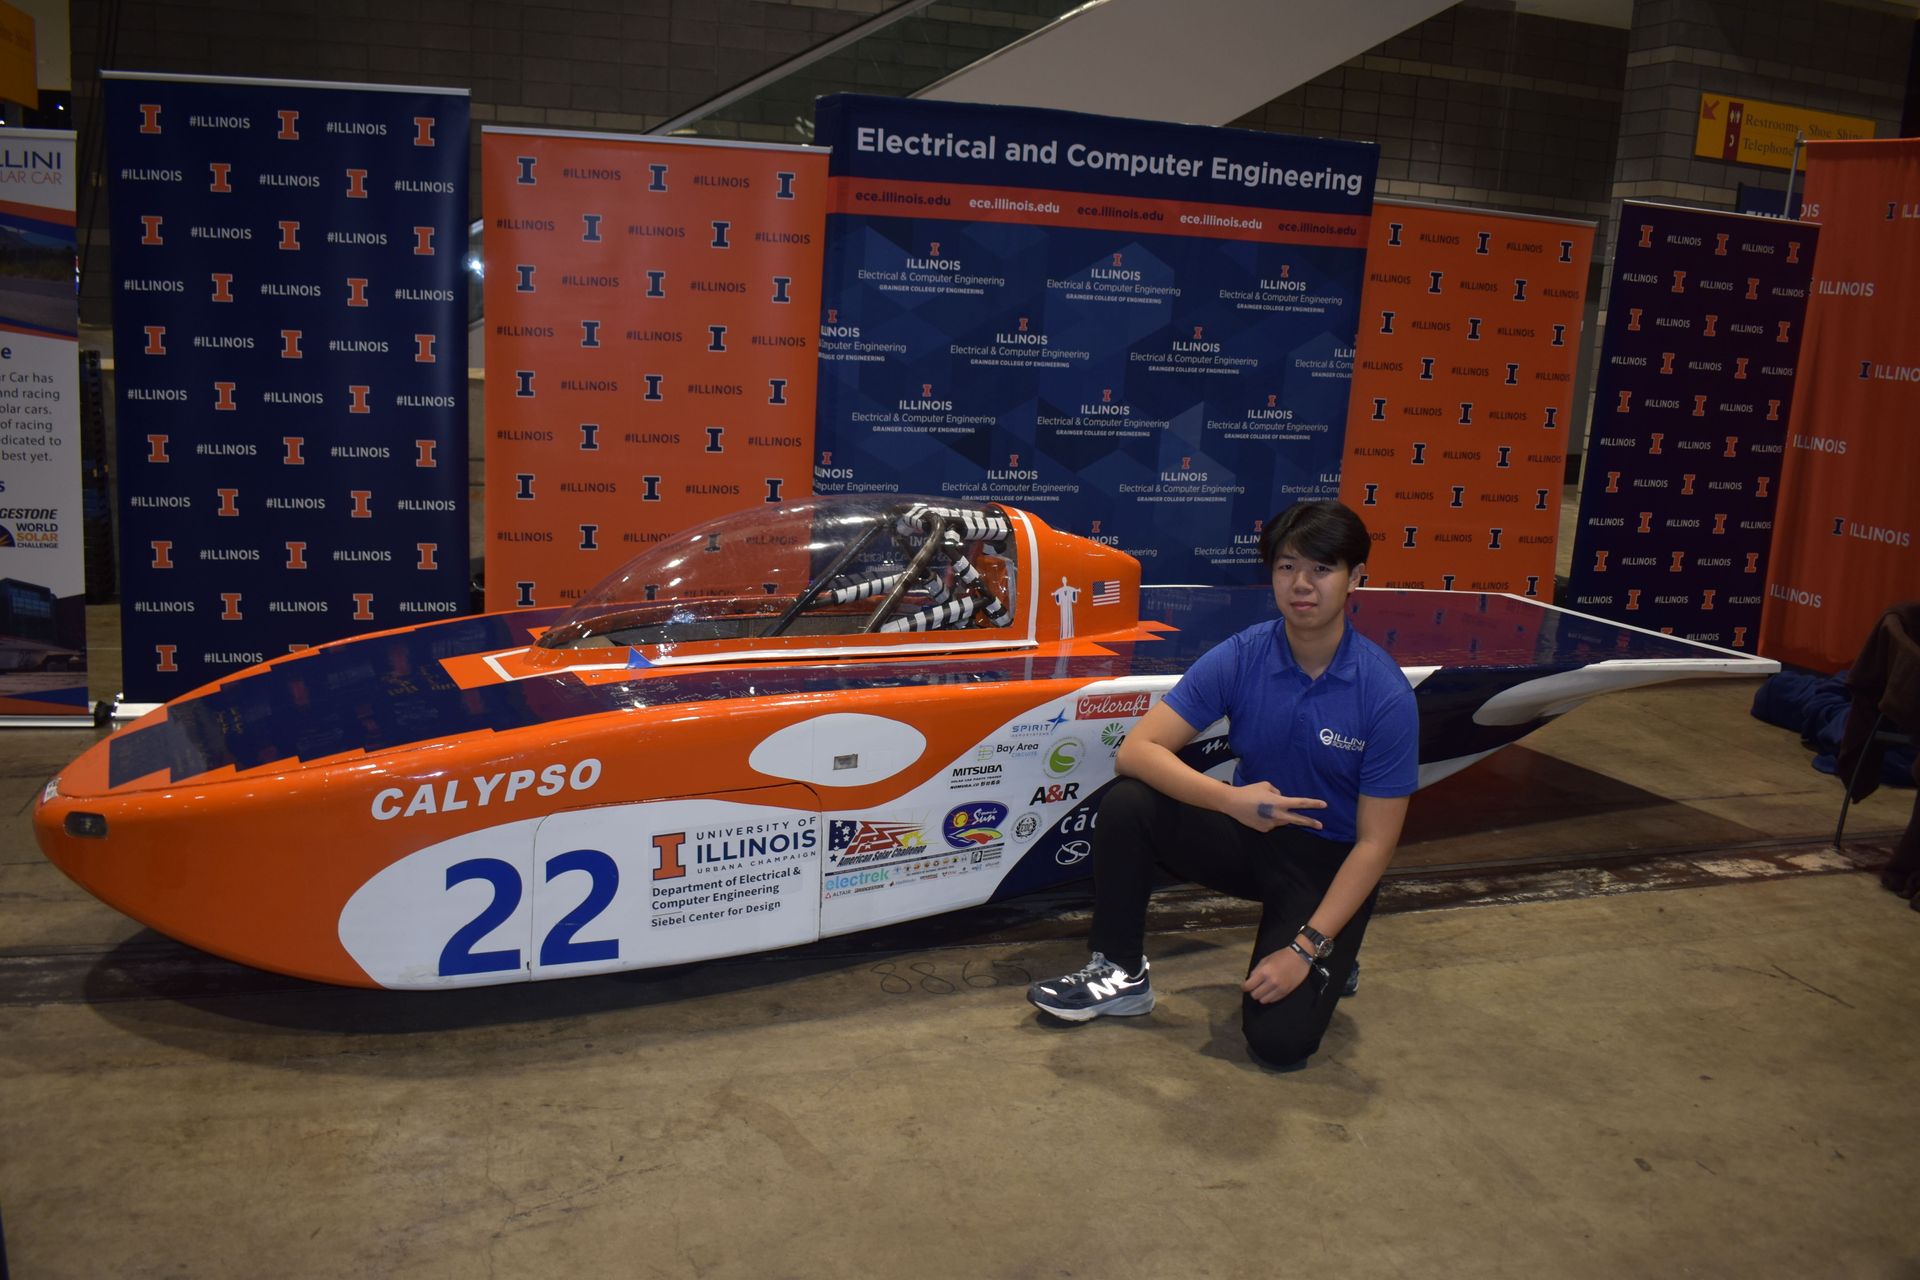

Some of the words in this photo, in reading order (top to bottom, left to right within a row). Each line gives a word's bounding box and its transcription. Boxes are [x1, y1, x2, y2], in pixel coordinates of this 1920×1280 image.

[189, 116, 250, 129] #ILLINOIS
[327, 122, 387, 135] #ILLINOIS
[857, 127, 995, 160] Electrical
[1005, 141, 1057, 164] and
[1067, 143, 1203, 177] Computer
[1211, 157, 1362, 195] Engineering
[32, 171, 62, 184] CAR
[121, 168, 182, 182] #ILLINOIS
[563, 168, 621, 181] #ILLINOIS
[259, 174, 320, 188] #ILLINOIS
[395, 180, 454, 194] #ILLINOIS
[693, 176, 750, 189] #ILLINOIS
[855, 191, 951, 206] ece.illinois.edu
[969, 198, 1060, 213] ece.illinois.edu
[1077, 205, 1164, 221] ece.illinois.edu
[1180, 214, 1262, 230] ece.illinois.edu
[191, 227, 252, 240] #ILLINOIS
[1278, 222, 1356, 236] ece.illinois.edu
[327, 232, 388, 245] #ILLINOIS
[755, 232, 811, 245] #ILLINOIS
[1420, 233, 1460, 245] #ILLINOIS
[1667, 235, 1701, 246] #ILLINOIS
[906, 258, 961, 270] ILLINOIS
[858, 270, 898, 280] Electrical
[901, 272, 906, 280] &
[909, 273, 952, 284] Computer
[955, 275, 1005, 286] Engineering
[1091, 268, 1141, 280] ILLINOIS
[1371, 273, 1411, 285] #ILLINOIS
[1623, 273, 1658, 284] #ILLINOIS
[562, 275, 619, 288] #ILLINOIS
[1047, 279, 1083, 290] Electrical
[1086, 282, 1091, 290] &
[1094, 282, 1132, 293] Computer
[1135, 284, 1181, 296] Engineering
[1260, 280, 1306, 291] ILLINOIS
[1460, 281, 1497, 292] #ILLINOIS
[1700, 280, 1733, 291] #ILLINOIS
[1819, 280, 1874, 297] ILLINOIS
[1412, 321, 1450, 331] #ILLINOIS
[1656, 318, 1690, 329] #ILLINOIS
[626, 330, 683, 342] #ILLINOIS
[996, 334, 1048, 345] ILLINOIS
[951, 345, 988, 355] Electrical
[991, 347, 996, 355] &
[999, 347, 1039, 357] Computer
[1042, 349, 1089, 360] Engineering
[1173, 341, 1220, 352] ILLINOIS
[1452, 367, 1489, 377] #ILLINOIS
[1689, 361, 1722, 372] #ILLINOIS
[10, 372, 28, 382] Car
[33, 372, 54, 383] has
[561, 381, 618, 392] #ILLINOIS
[22, 389, 60, 402] racing
[128, 389, 188, 401] #ILLINOIS
[25, 406, 52, 415] cars.
[899, 400, 952, 411] ILLINOIS
[1081, 405, 1130, 415] ILLINOIS
[1720, 403, 1753, 413] #ILLINOIS
[1248, 409, 1293, 419] ILLINOIS
[1404, 407, 1442, 417] #ILLINOIS
[852, 412, 891, 422] Electrical
[893, 414, 899, 422] &
[902, 413, 944, 424] Computer
[947, 415, 996, 425] Engineering
[1, 419, 11, 428] of
[16, 421, 52, 432] racing
[50, 437, 61, 446] to
[748, 437, 802, 447] #ILLINOIS
[1600, 437, 1635, 447] #ILLINOIS
[1793, 434, 1846, 455] ILLINOIS
[197, 444, 257, 456] #ILLINOIS
[2, 450, 26, 460] best
[31, 452, 52, 463] yet.
[987, 470, 1038, 480] ILLINOIS
[1161, 472, 1208, 481] ILLINOIS
[685, 484, 740, 495] #ILLINOIS
[942, 482, 979, 492] Electrical
[982, 483, 987, 491] &
[990, 483, 1030, 493] Computer
[1032, 484, 1079, 493] Engineering
[1634, 479, 1668, 488] #ILLINOIS
[1395, 491, 1434, 501] #ILLINOIS
[266, 498, 325, 509] #ILLINOIS
[16, 522, 58, 532] WORLD
[17, 532, 58, 541] SOLAR
[1435, 534, 1472, 543] #ILLINOIS
[1850, 522, 1910, 546] ILLINOIS
[200, 549, 259, 561] #ILLINOIS
[1697, 558, 1731, 567] #ILLINOIS
[1770, 584, 1822, 608] ILLINOIS
[135, 601, 195, 613] #ILLINOIS
[204, 652, 263, 664] #ILLINOIS
[1078, 694, 1150, 716] Coilcraft
[1012, 724, 1050, 732] SPIRIT
[1334, 733, 1365, 746] ILLINI
[996, 744, 1014, 753] Bay
[1016, 742, 1039, 751] Area
[953, 765, 1002, 777] MITSUBA
[371, 758, 603, 821] CALYPSO
[1029, 783, 1080, 806] A&R
[696, 821, 790, 840] UNIVERSITY
[798, 816, 817, 827] OF
[697, 829, 816, 864] ILLINOIS
[837, 852, 874, 867] American
[872, 851, 892, 862] Solar
[891, 845, 927, 858] Challenge
[698, 863, 743, 874] URBANA
[751, 851, 816, 867] CHAMPAIGN
[652, 877, 723, 897] Department
[726, 877, 737, 887] of
[740, 868, 790, 884] Electrical
[793, 866, 801, 875] &
[825, 868, 889, 891] electrek
[652, 893, 711, 910] Computer
[713, 883, 779, 902] Engineering
[438, 849, 620, 977] 22
[652, 914, 685, 927] Siebel
[689, 909, 725, 922] Center
[728, 907, 743, 916] for
[746, 900, 781, 913] Design
